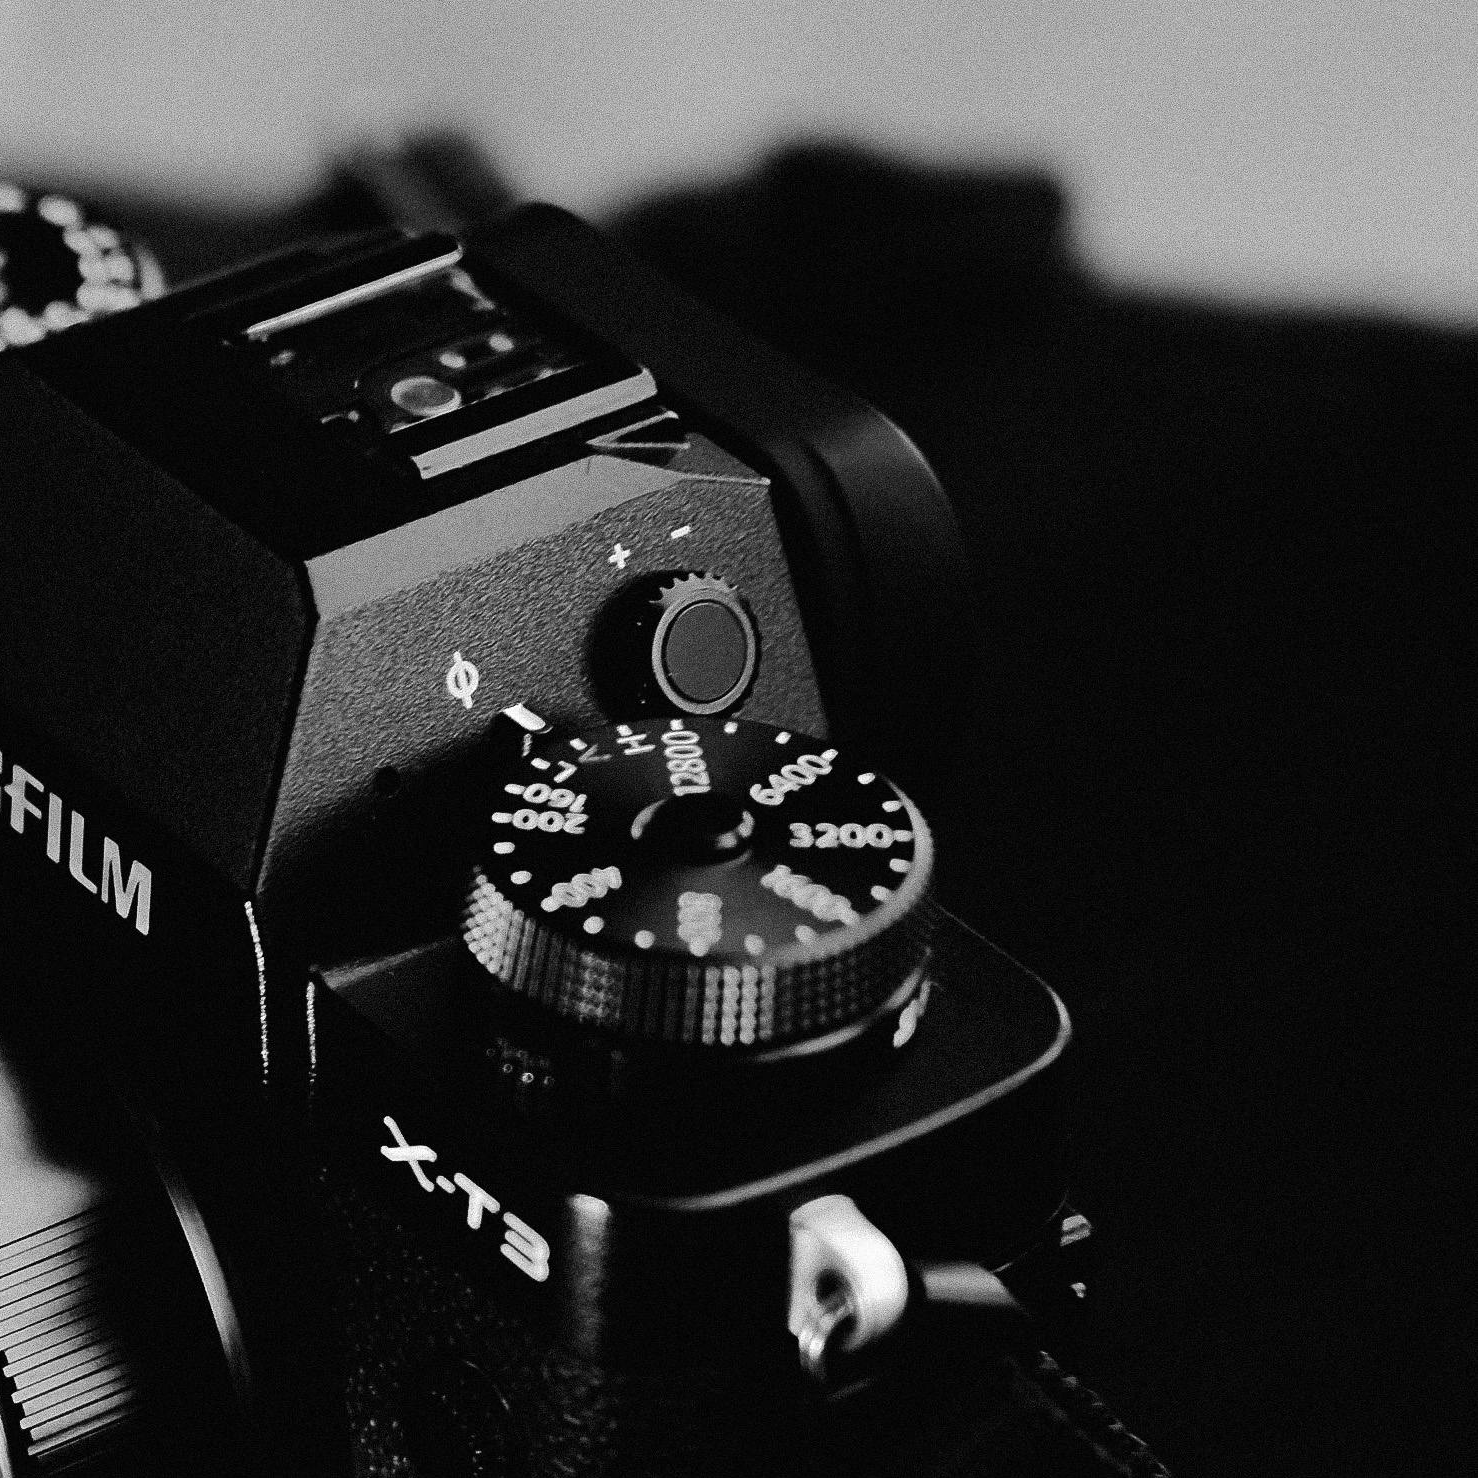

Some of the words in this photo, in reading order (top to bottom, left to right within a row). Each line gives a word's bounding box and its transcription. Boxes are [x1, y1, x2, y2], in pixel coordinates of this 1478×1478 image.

[660, 730, 711, 797] 12800
[789, 822, 894, 848] 3200
[380, 1115, 550, 1282] X-T3
